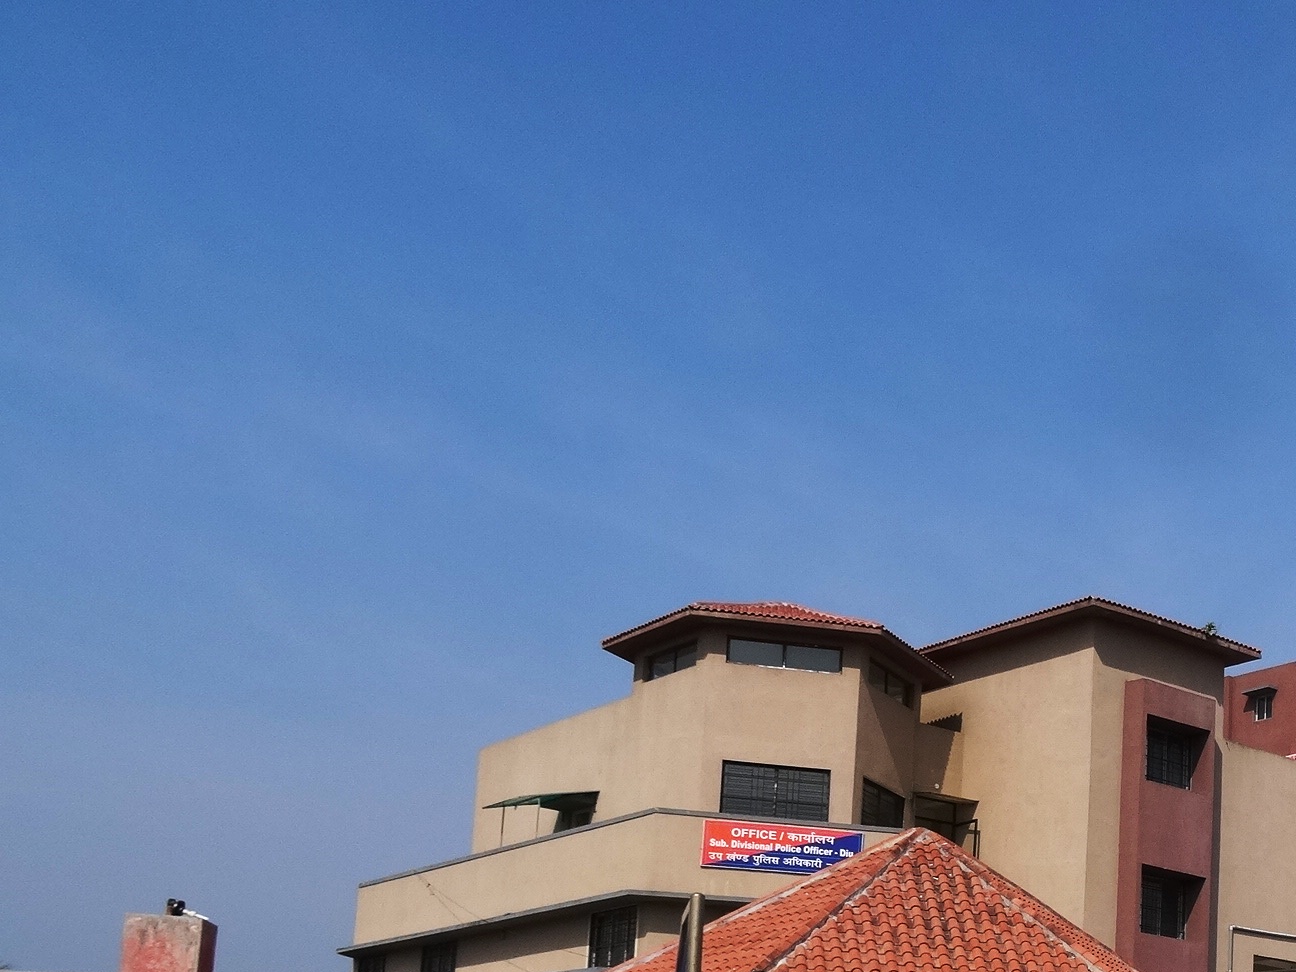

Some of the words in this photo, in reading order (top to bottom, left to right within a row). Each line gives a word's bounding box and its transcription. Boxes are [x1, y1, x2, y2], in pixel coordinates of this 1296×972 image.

[731, 827, 777, 840] OFFICE
[780, 832, 784, 840] /
[787, 832, 835, 845] कार्यालय
[709, 838, 729, 848] Sub.
[731, 840, 773, 851] Divisional
[775, 844, 801, 854] Police
[803, 846, 832, 856] Officer
[840, 850, 854, 858] Diu
[708, 852, 722, 860] उप
[752, 854, 779, 866] पुलिस
[782, 856, 823, 868] अधिकारी
